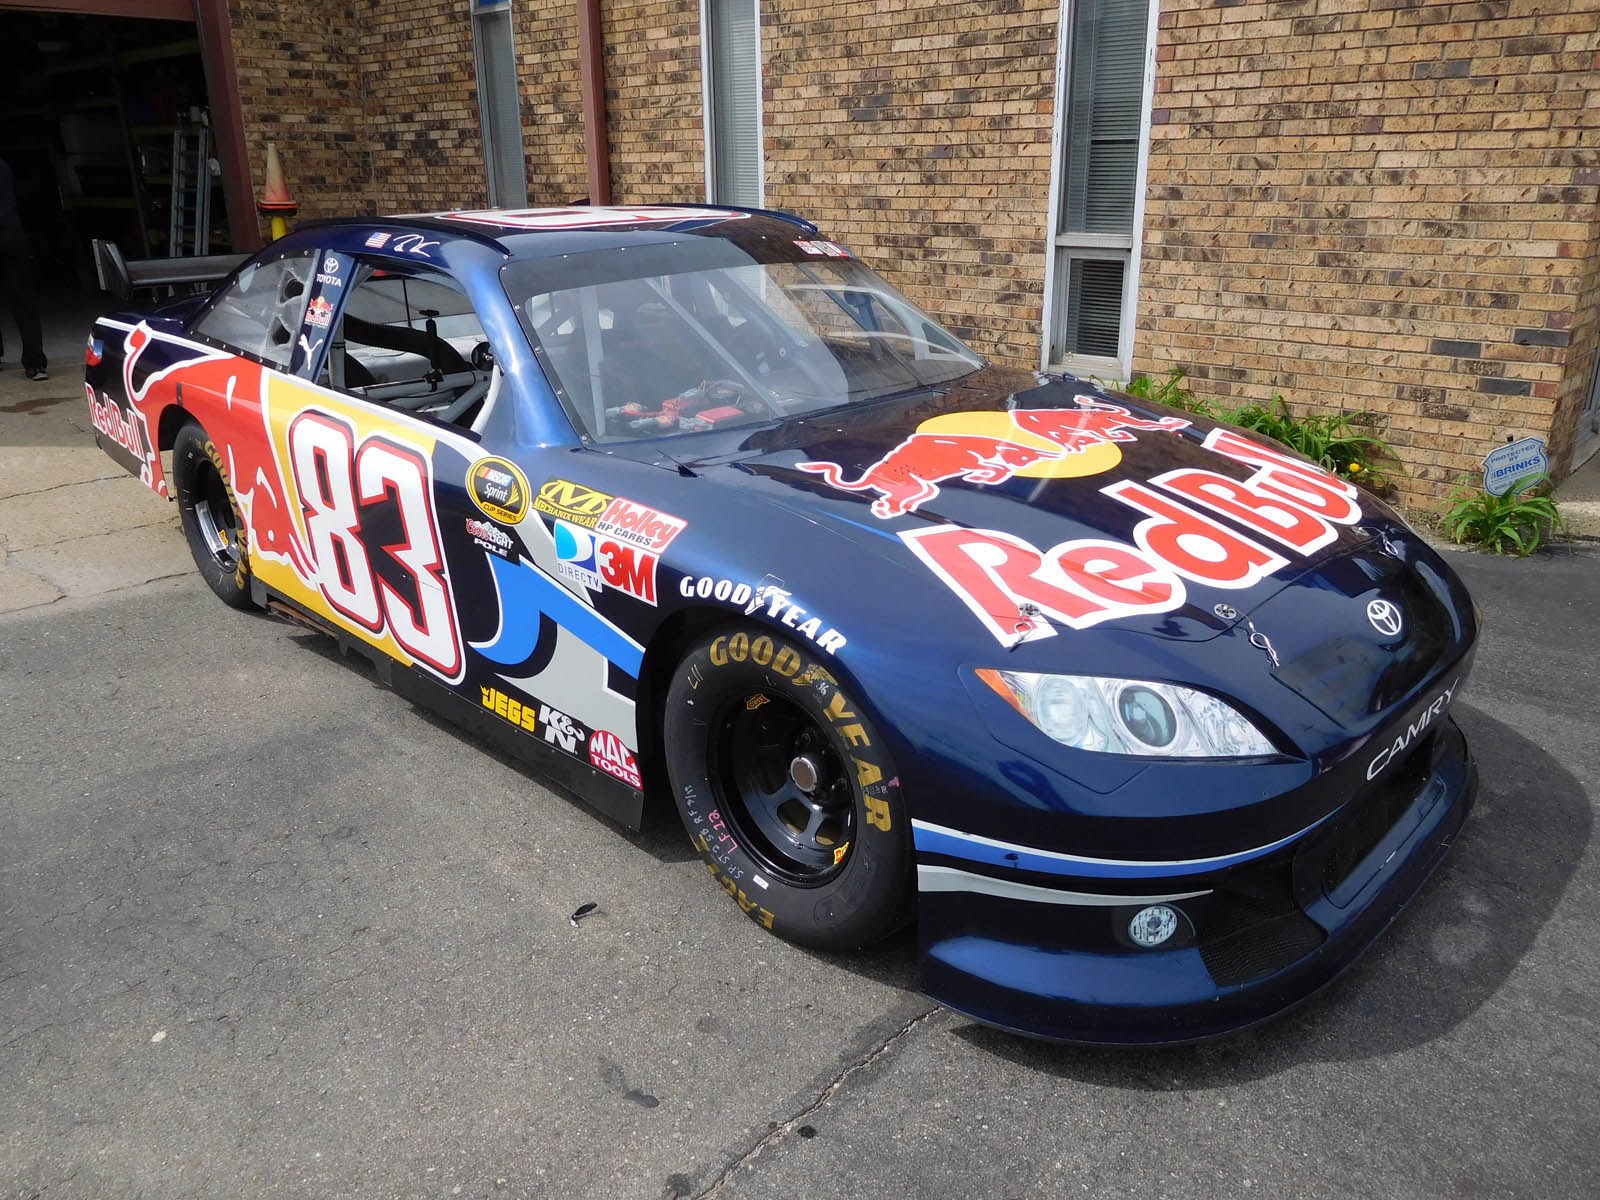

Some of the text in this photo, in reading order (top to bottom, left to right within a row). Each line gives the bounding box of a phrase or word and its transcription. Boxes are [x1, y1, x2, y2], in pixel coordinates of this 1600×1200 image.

[316, 273, 342, 287] TOYOTA
[1495, 455, 1541, 478] BRINKS
[484, 482, 509, 501] Sprint
[483, 503, 518, 522] CUP SERIES
[533, 497, 598, 529] MECHANIX WEAR
[602, 499, 679, 548] Holley
[286, 404, 466, 686] 83
[474, 538, 508, 557] POLE
[489, 532, 514, 550] LIGHT
[597, 521, 652, 547] HP CARBS
[557, 562, 600, 589] DIRECTV
[600, 540, 655, 603] 3M
[482, 687, 536, 733] JEGS
[1366, 678, 1459, 781] CAMRY
[590, 731, 639, 775] MAC
[591, 753, 641, 787] TOOLS
